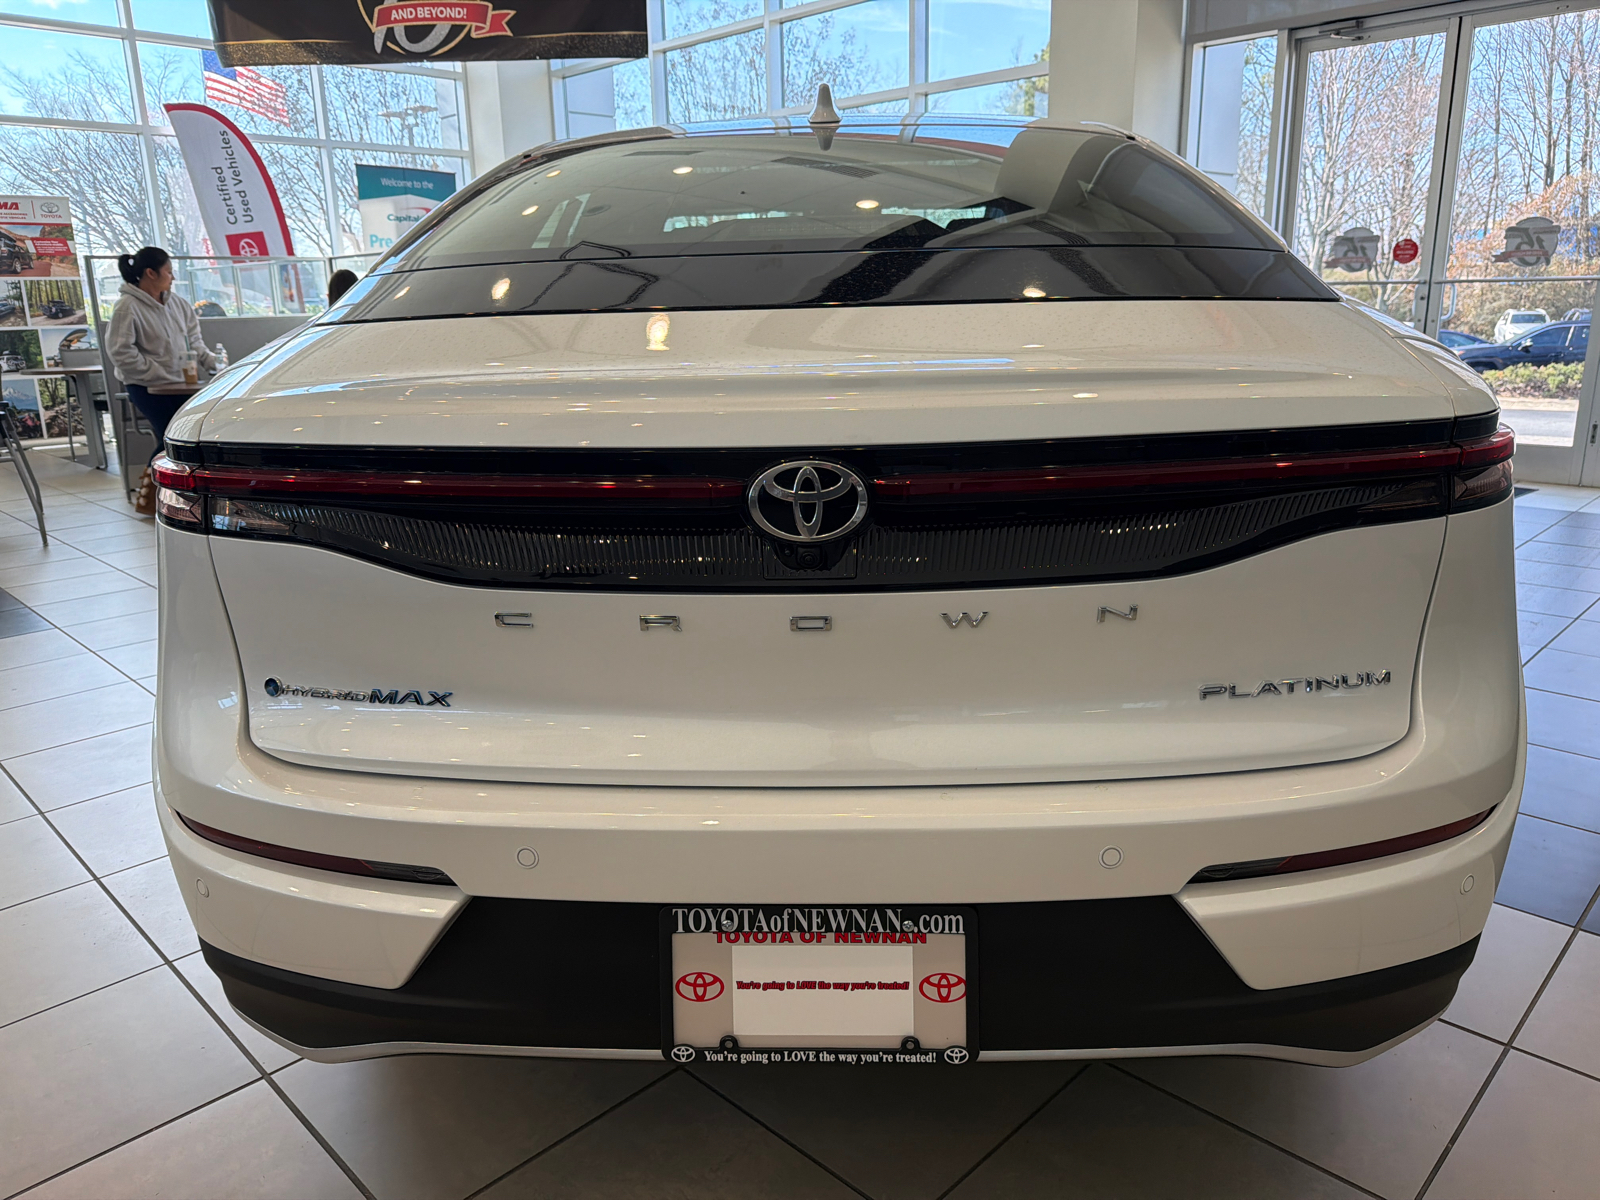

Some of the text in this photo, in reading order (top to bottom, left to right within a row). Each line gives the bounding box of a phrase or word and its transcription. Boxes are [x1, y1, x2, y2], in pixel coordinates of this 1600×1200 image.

[391, 7, 467, 21] AND BEYOND!
[220, 130, 254, 223] Used Vehicles
[380, 178, 434, 190] Welcome to the
[211, 166, 238, 225] Certified
[1198, 669, 1391, 700] PLATINUM
[714, 931, 928, 945] TOYOTA OF NEWNAN
[736, 980, 910, 991] You're going to LOVE the way you're treated!
[704, 1051, 937, 1065] You're going to LOVE the way you're treated!
